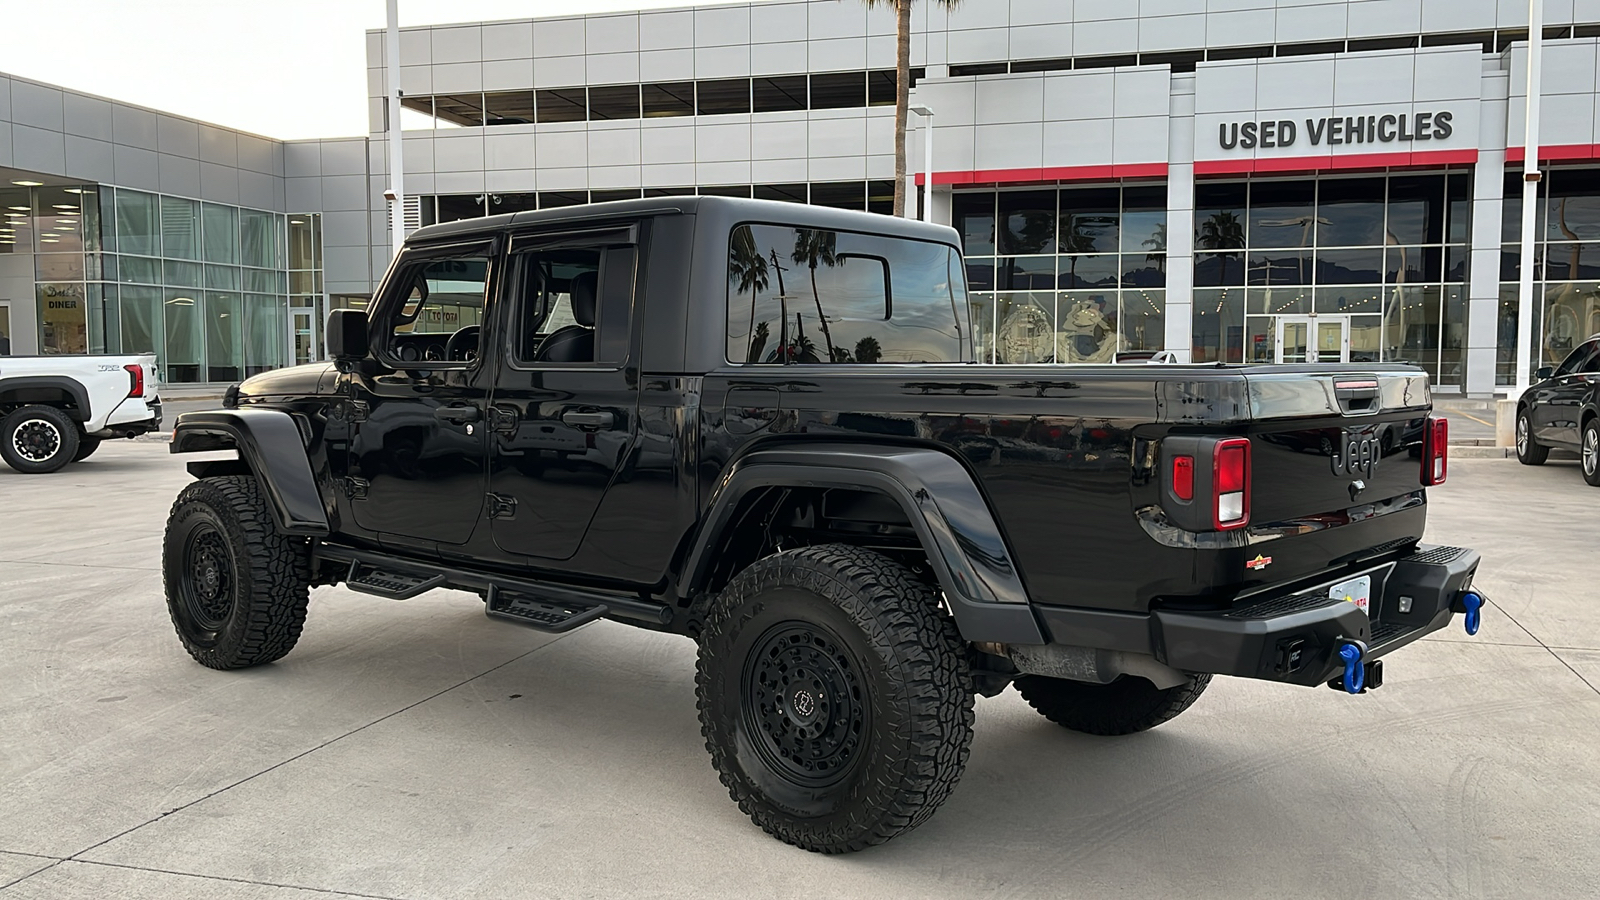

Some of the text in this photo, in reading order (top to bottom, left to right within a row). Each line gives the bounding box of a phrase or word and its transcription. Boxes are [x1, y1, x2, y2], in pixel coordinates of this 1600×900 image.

[1218, 111, 1454, 150] USED VEHICLES
[48, 300, 77, 309] DINER
[1330, 431, 1382, 480] Jeep
